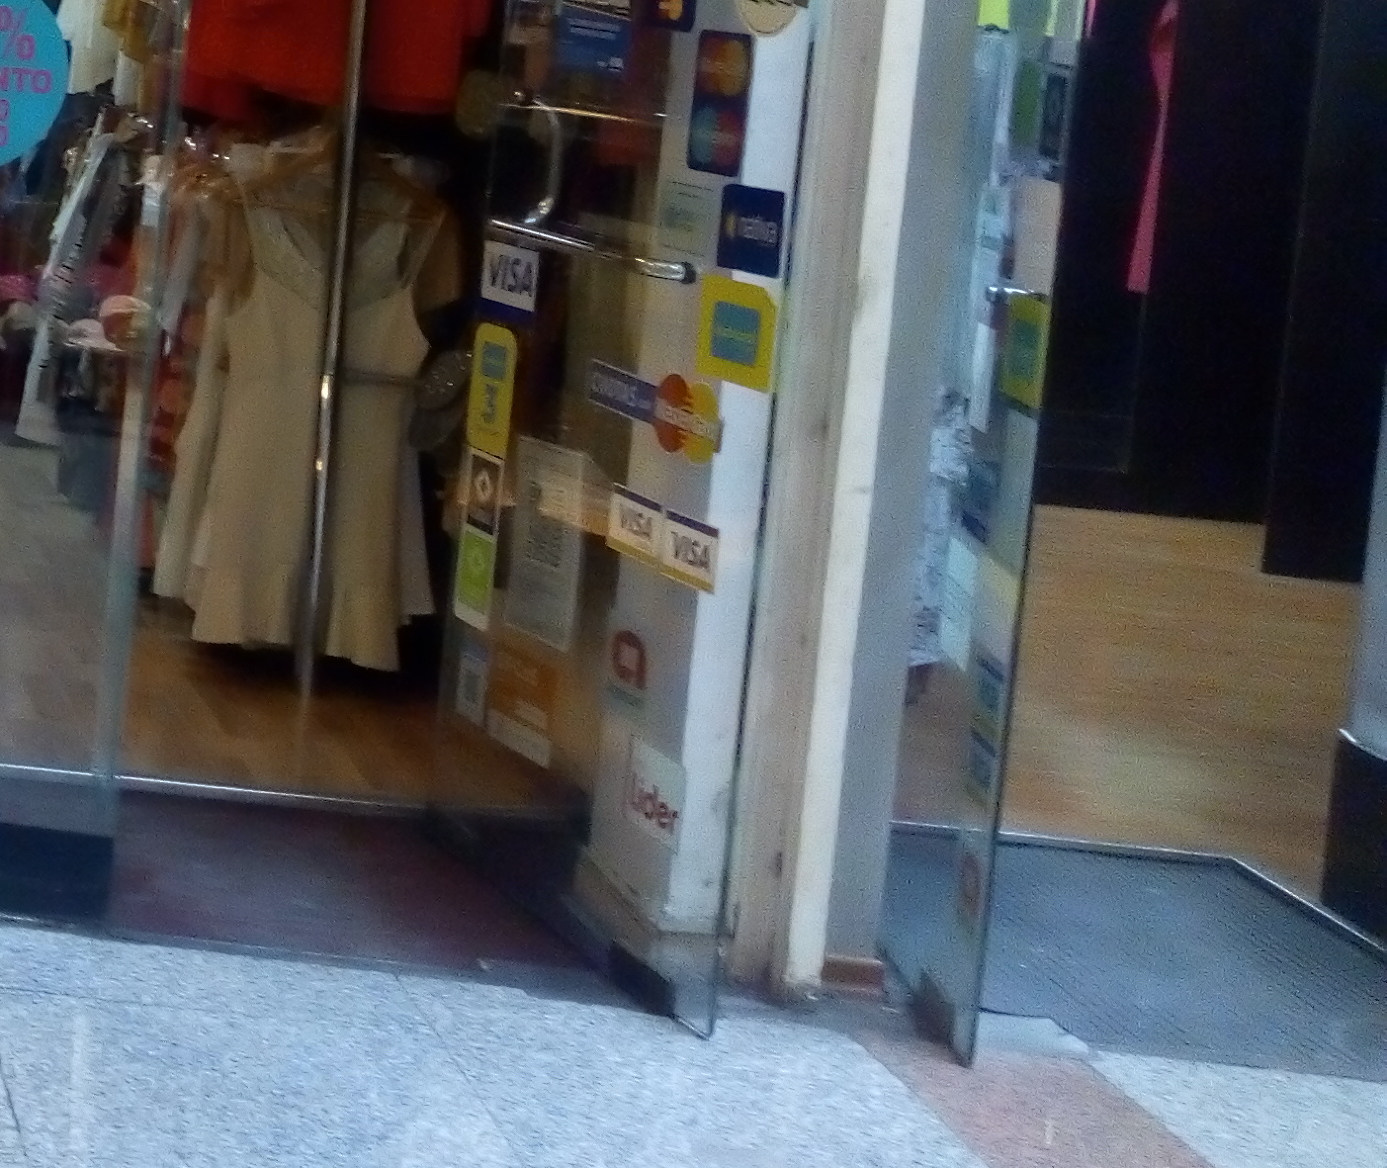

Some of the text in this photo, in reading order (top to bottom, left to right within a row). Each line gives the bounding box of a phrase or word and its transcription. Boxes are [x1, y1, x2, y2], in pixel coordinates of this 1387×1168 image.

[490, 253, 534, 299] VISA
[618, 499, 653, 540] VISA
[672, 530, 711, 572] VISA
